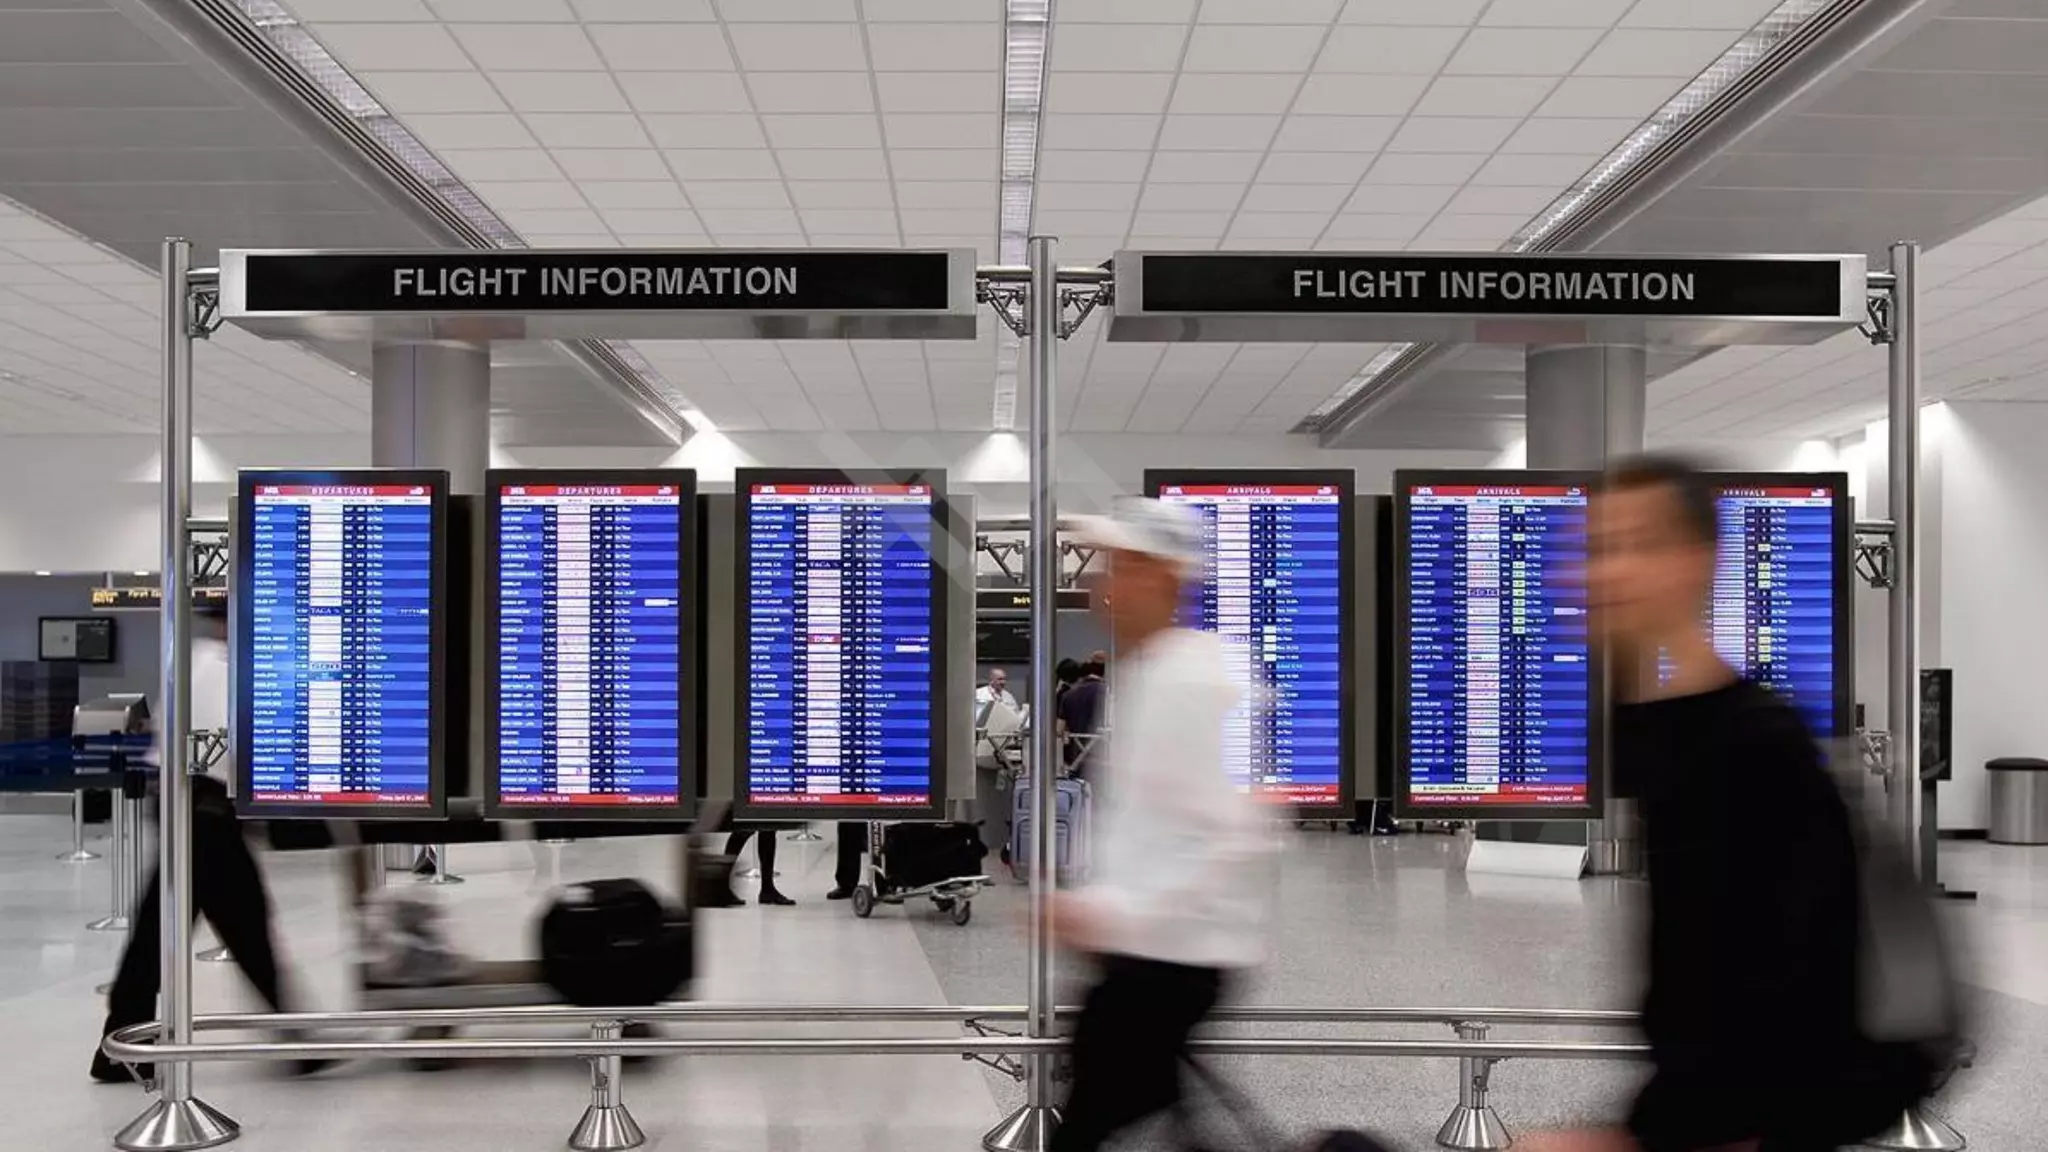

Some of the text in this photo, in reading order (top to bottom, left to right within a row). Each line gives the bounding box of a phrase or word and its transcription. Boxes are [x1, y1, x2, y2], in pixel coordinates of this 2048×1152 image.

[394, 265, 798, 297] FLIGHT INFORMATION
[1293, 269, 1695, 301] FLIGHT INFORMATION
[311, 486, 375, 495] DEPARTURES
[558, 486, 622, 496] DEPARTURES
[808, 486, 874, 494] DEPARTURES
[1226, 486, 1272, 495] ARRIVALS
[1476, 487, 1521, 496] ARRIVALS
